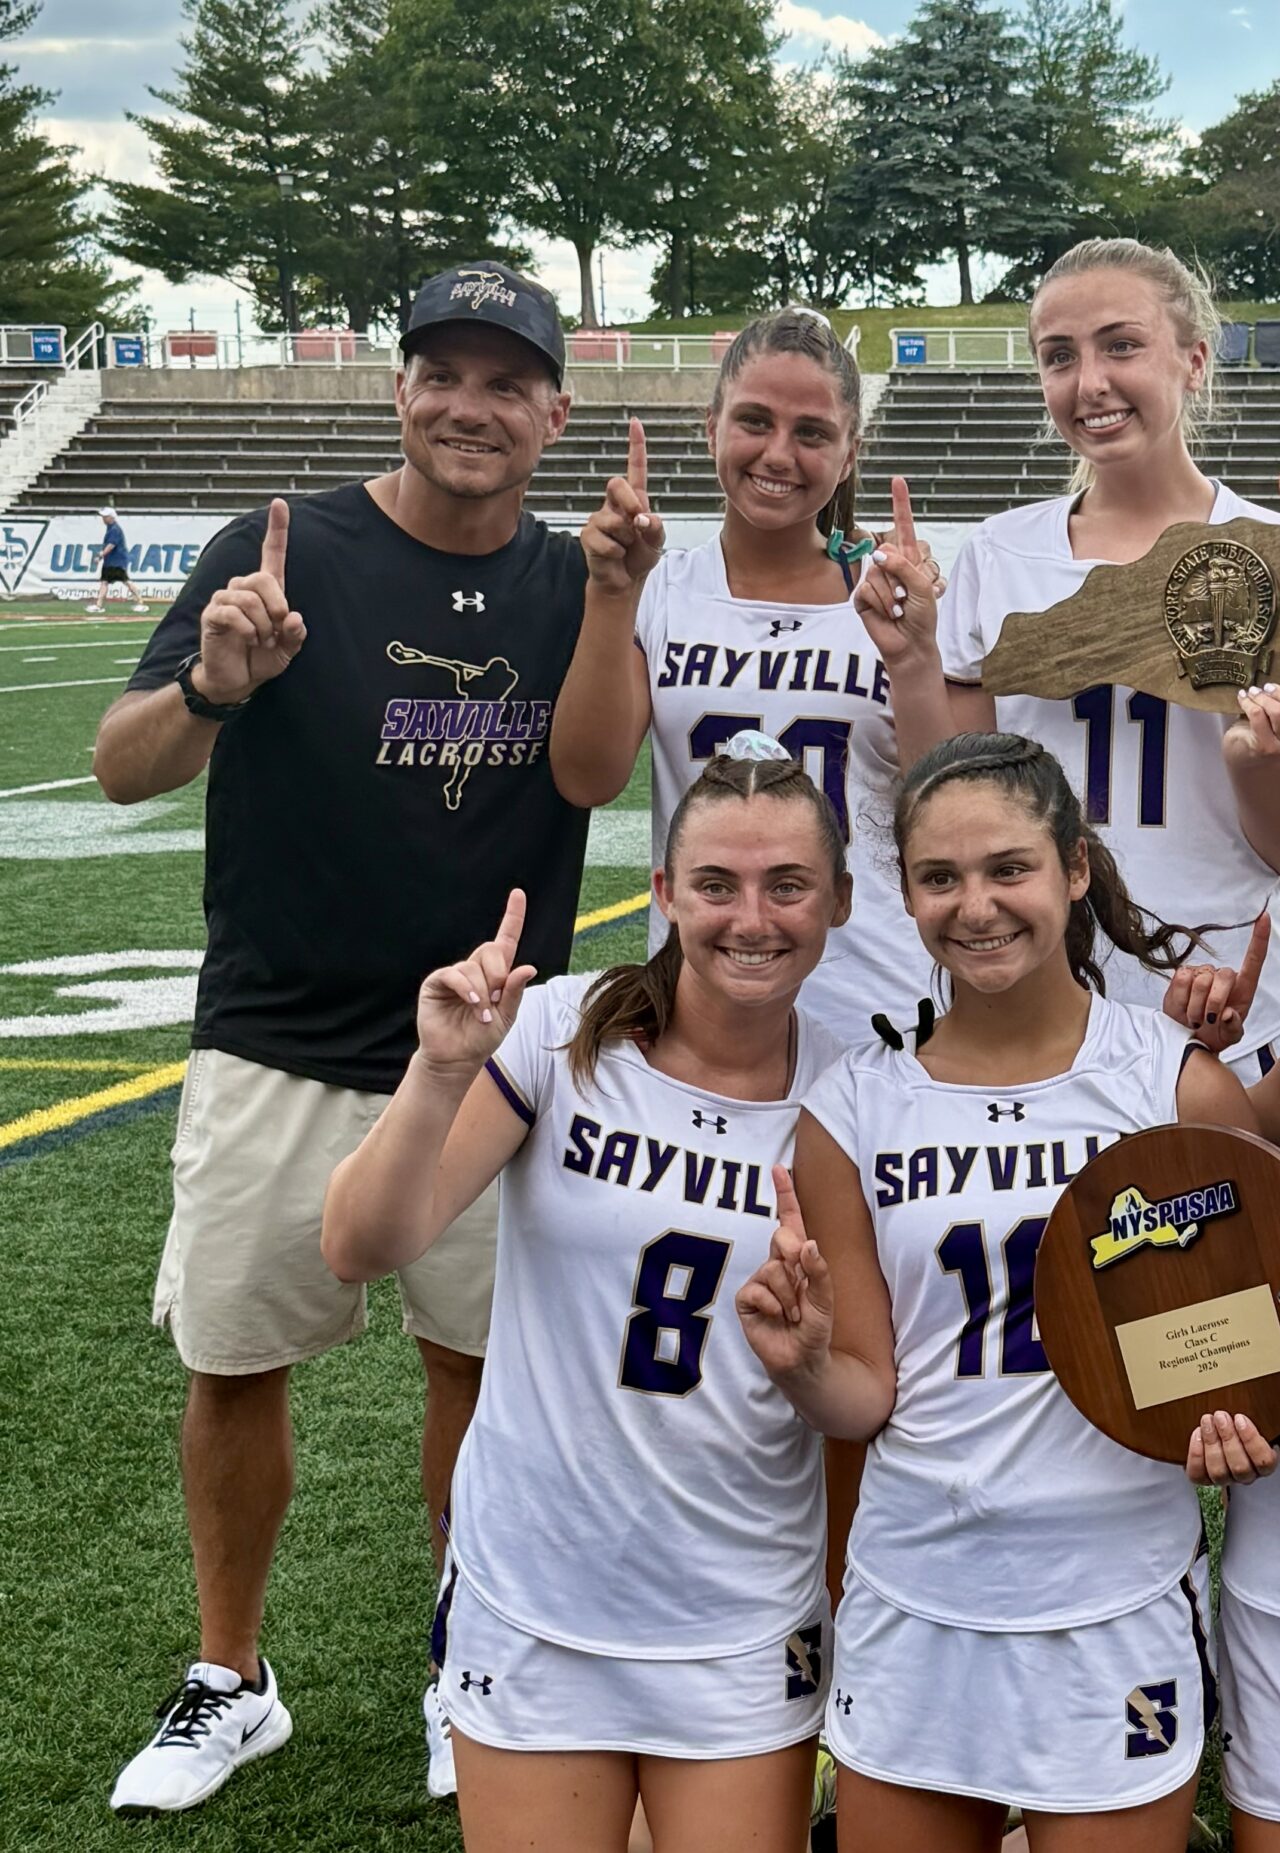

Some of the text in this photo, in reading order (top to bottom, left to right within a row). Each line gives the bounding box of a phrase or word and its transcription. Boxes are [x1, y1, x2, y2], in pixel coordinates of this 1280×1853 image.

[50, 543, 200, 573] ULTMATE
[1173, 546, 1210, 583] STATE
[1213, 543, 1257, 571] PUBLIC
[658, 641, 892, 706] SAYVILLE
[380, 698, 551, 741] SAYVILLE
[375, 741, 544, 766] LACROSSE
[1073, 683, 1169, 829] 11
[1111, 1183, 1236, 1243] NYSPHSAA
[617, 1227, 735, 1399] 8
[1165, 1316, 1231, 1342] Girls Lacrosse
[1158, 1338, 1251, 1371] Regional Champions
[1184, 1332, 1219, 1350] Class C
[1197, 1360, 1219, 1374] 2026
